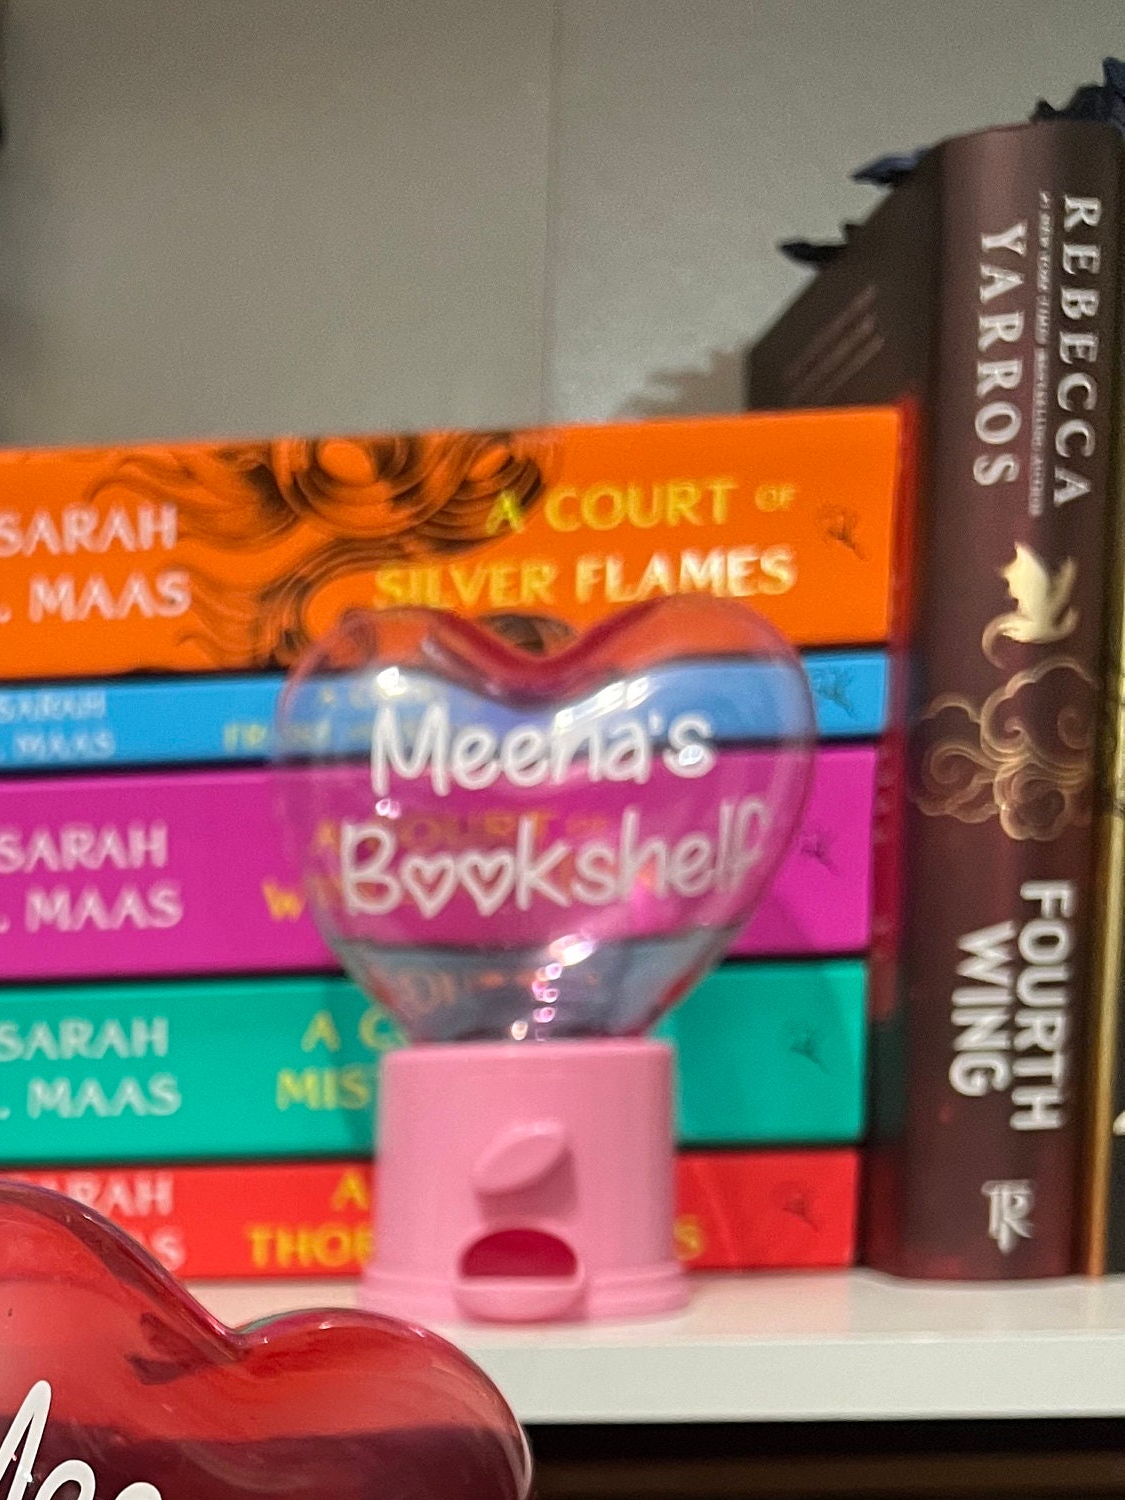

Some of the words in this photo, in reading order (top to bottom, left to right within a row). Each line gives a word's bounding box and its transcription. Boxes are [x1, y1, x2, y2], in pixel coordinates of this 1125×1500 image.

[973, 222, 1027, 486] YARROS
[1053, 197, 1102, 507] REBECCA
[484, 490, 524, 535] A
[544, 478, 739, 532] COURT
[755, 484, 795, 512] OF
[29, 570, 192, 623] MAAS
[375, 554, 556, 609] SILVER
[577, 544, 797, 602] FLAMES
[371, 703, 716, 796] Meena's
[27, 880, 184, 933] MAAS
[301, 1010, 340, 1052] A
[949, 920, 1015, 1096] WING
[1010, 880, 1074, 1130] FOURTH
[27, 1072, 182, 1119] MAAS
[277, 1063, 371, 1111] MIS
[38, 1170, 174, 1216] RAH
[331, 1166, 370, 1212] A
